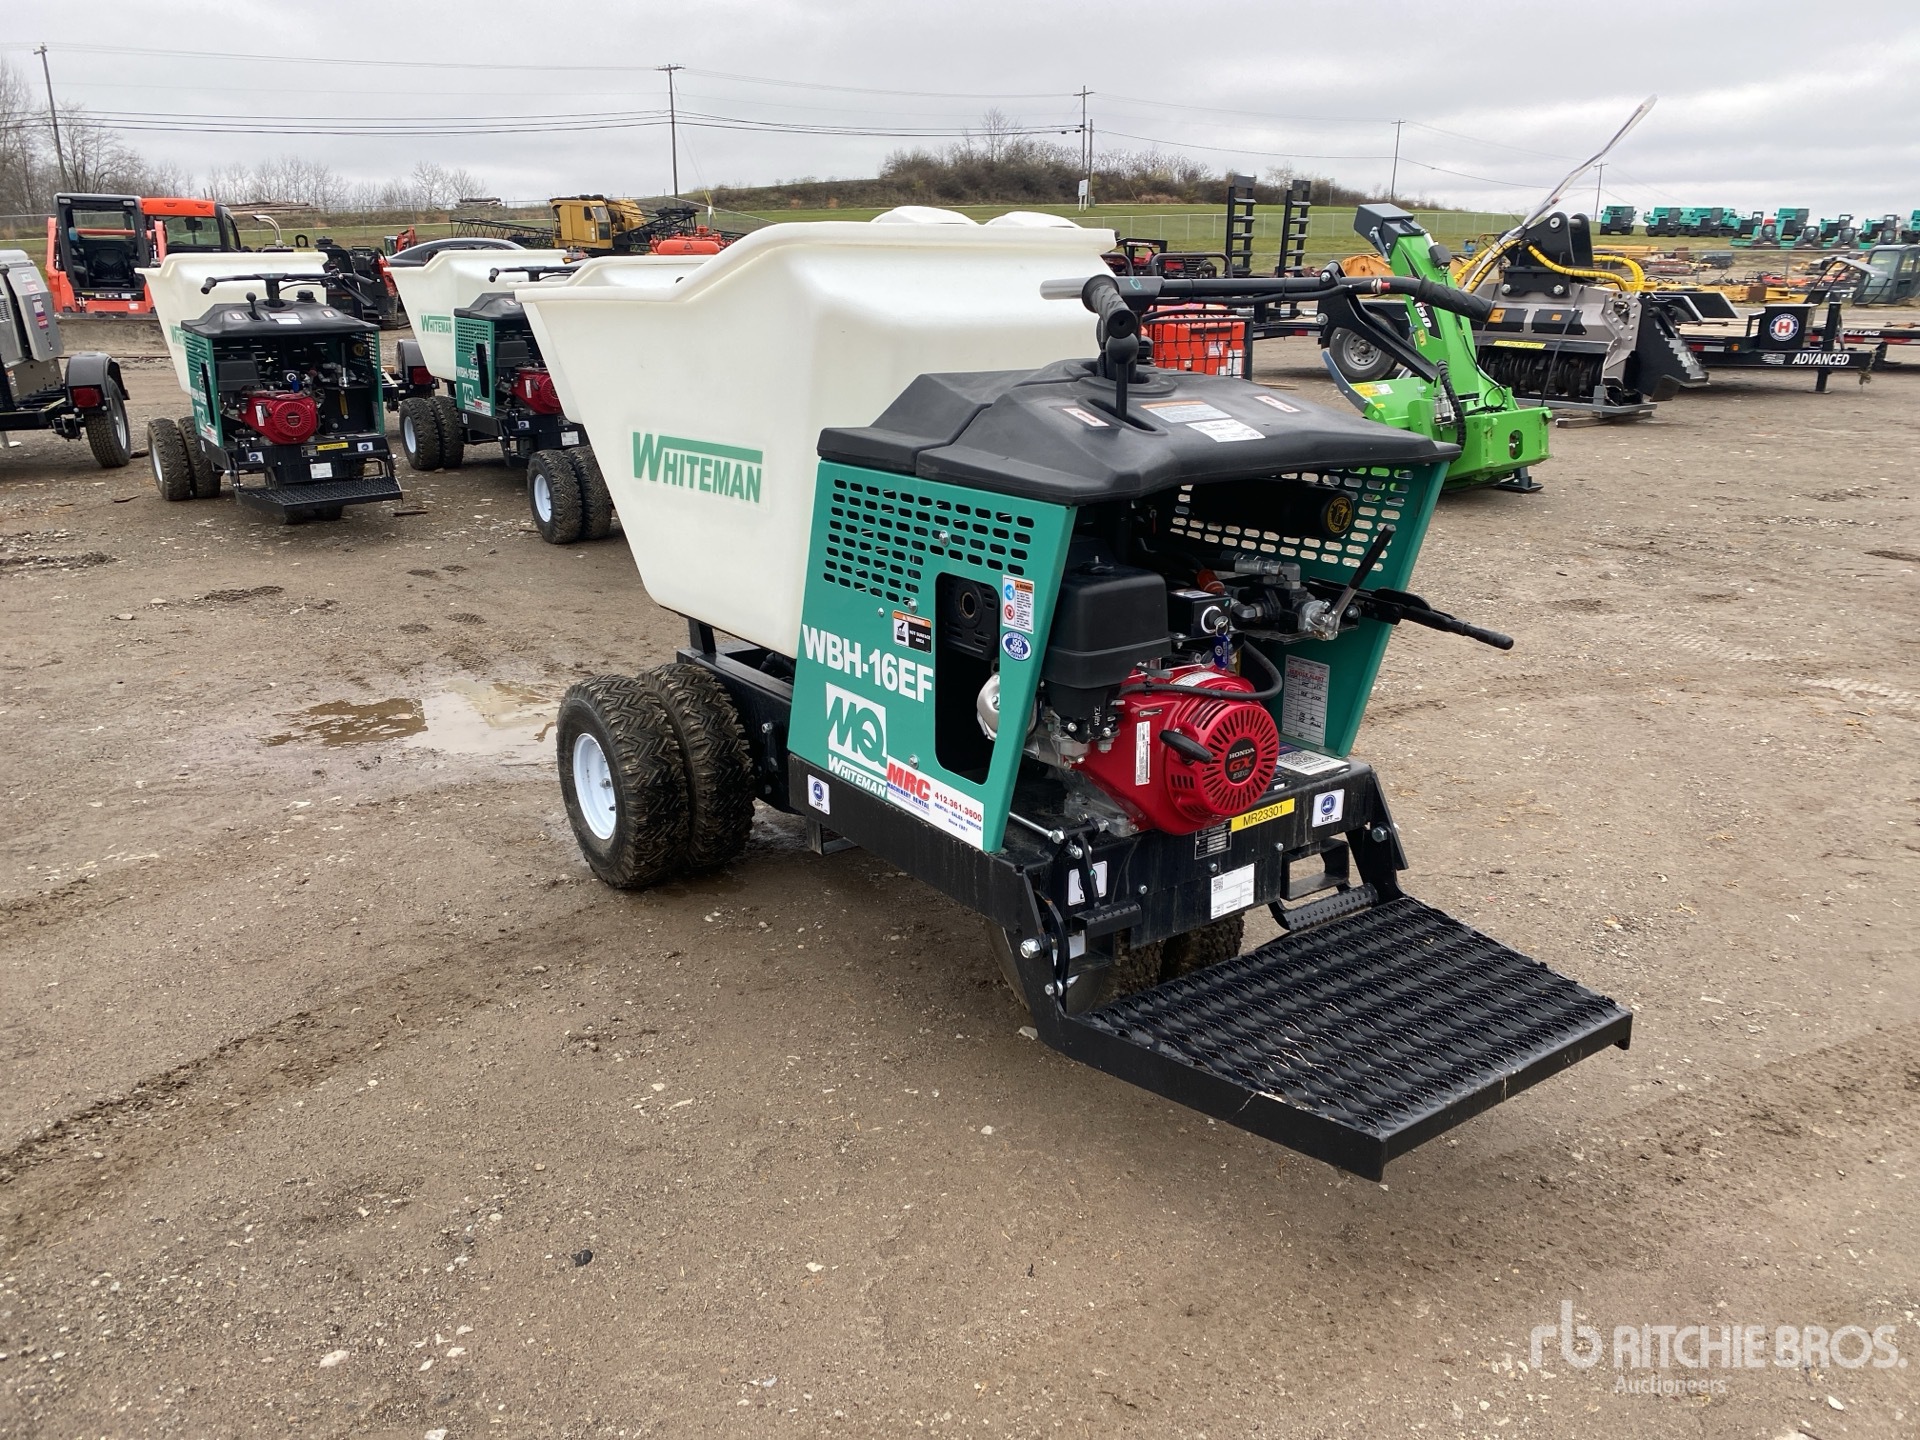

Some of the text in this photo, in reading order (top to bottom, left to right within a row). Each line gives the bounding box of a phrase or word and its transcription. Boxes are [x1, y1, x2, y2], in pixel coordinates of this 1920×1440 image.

[421, 315, 452, 334] WHITEMAN
[1778, 322, 1791, 333] H
[1792, 353, 1850, 366] ADVANCED
[632, 431, 763, 504] WHITEMAN
[1009, 644, 1024, 655] 9001
[1012, 638, 1023, 648] ISO
[802, 623, 934, 703] WBH-16EF
[1229, 747, 1256, 760] HONDA
[1229, 756, 1253, 772] GX
[828, 753, 887, 798] WHITEMAN
[887, 763, 931, 802] MRC
[912, 795, 930, 810] RENTAL
[1243, 804, 1284, 827] MR23301
[1321, 814, 1334, 823] LIFT
